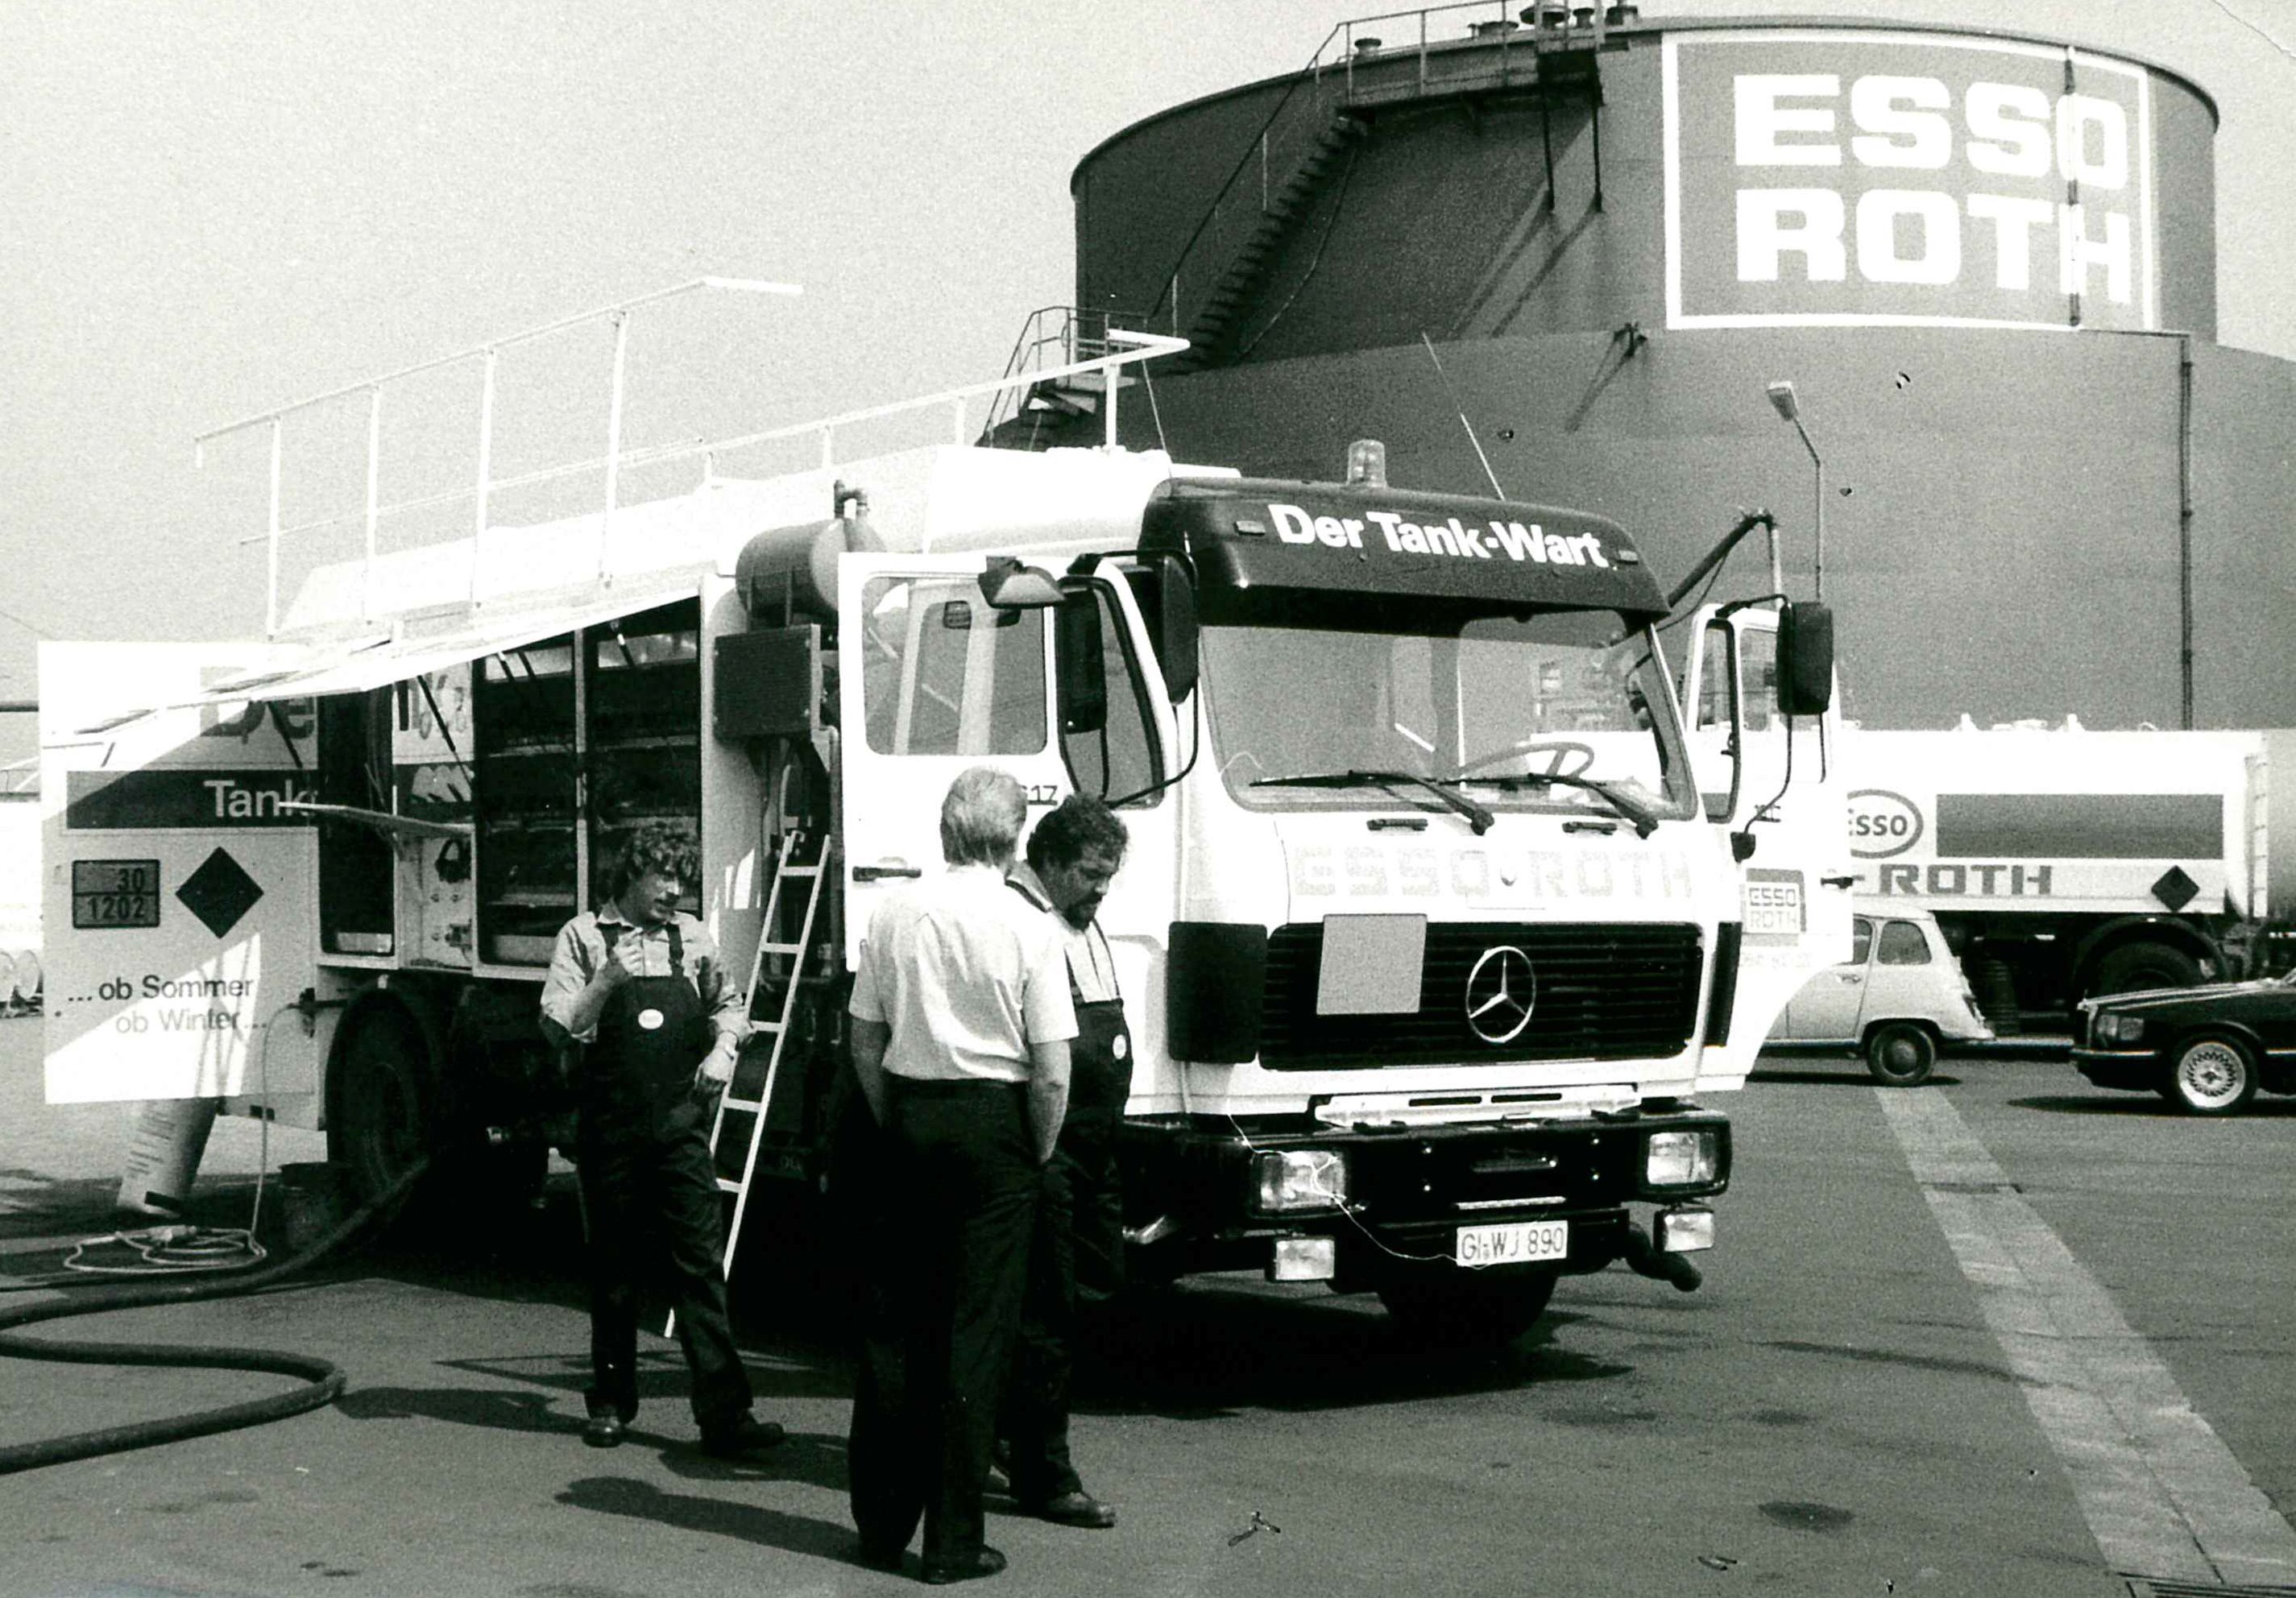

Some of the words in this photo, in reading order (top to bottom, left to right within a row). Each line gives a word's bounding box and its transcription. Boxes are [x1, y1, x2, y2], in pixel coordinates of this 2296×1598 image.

[1734, 74, 2128, 190] ESSO
[1735, 188, 2132, 304] ROTH
[1267, 503, 1365, 548] Der
[117, 867, 146, 892] 30
[1294, 846, 1490, 897] ESSO
[1527, 850, 1693, 899] ROTH
[1879, 863, 2052, 896] ROTH
[87, 896, 145, 920] 1202
[1749, 887, 1797, 907] ESSO
[1750, 910, 1797, 929] ROTH
[142, 974, 254, 999] Sommer
[115, 1009, 149, 1034] ob
[1527, 1227, 1565, 1255] 890
